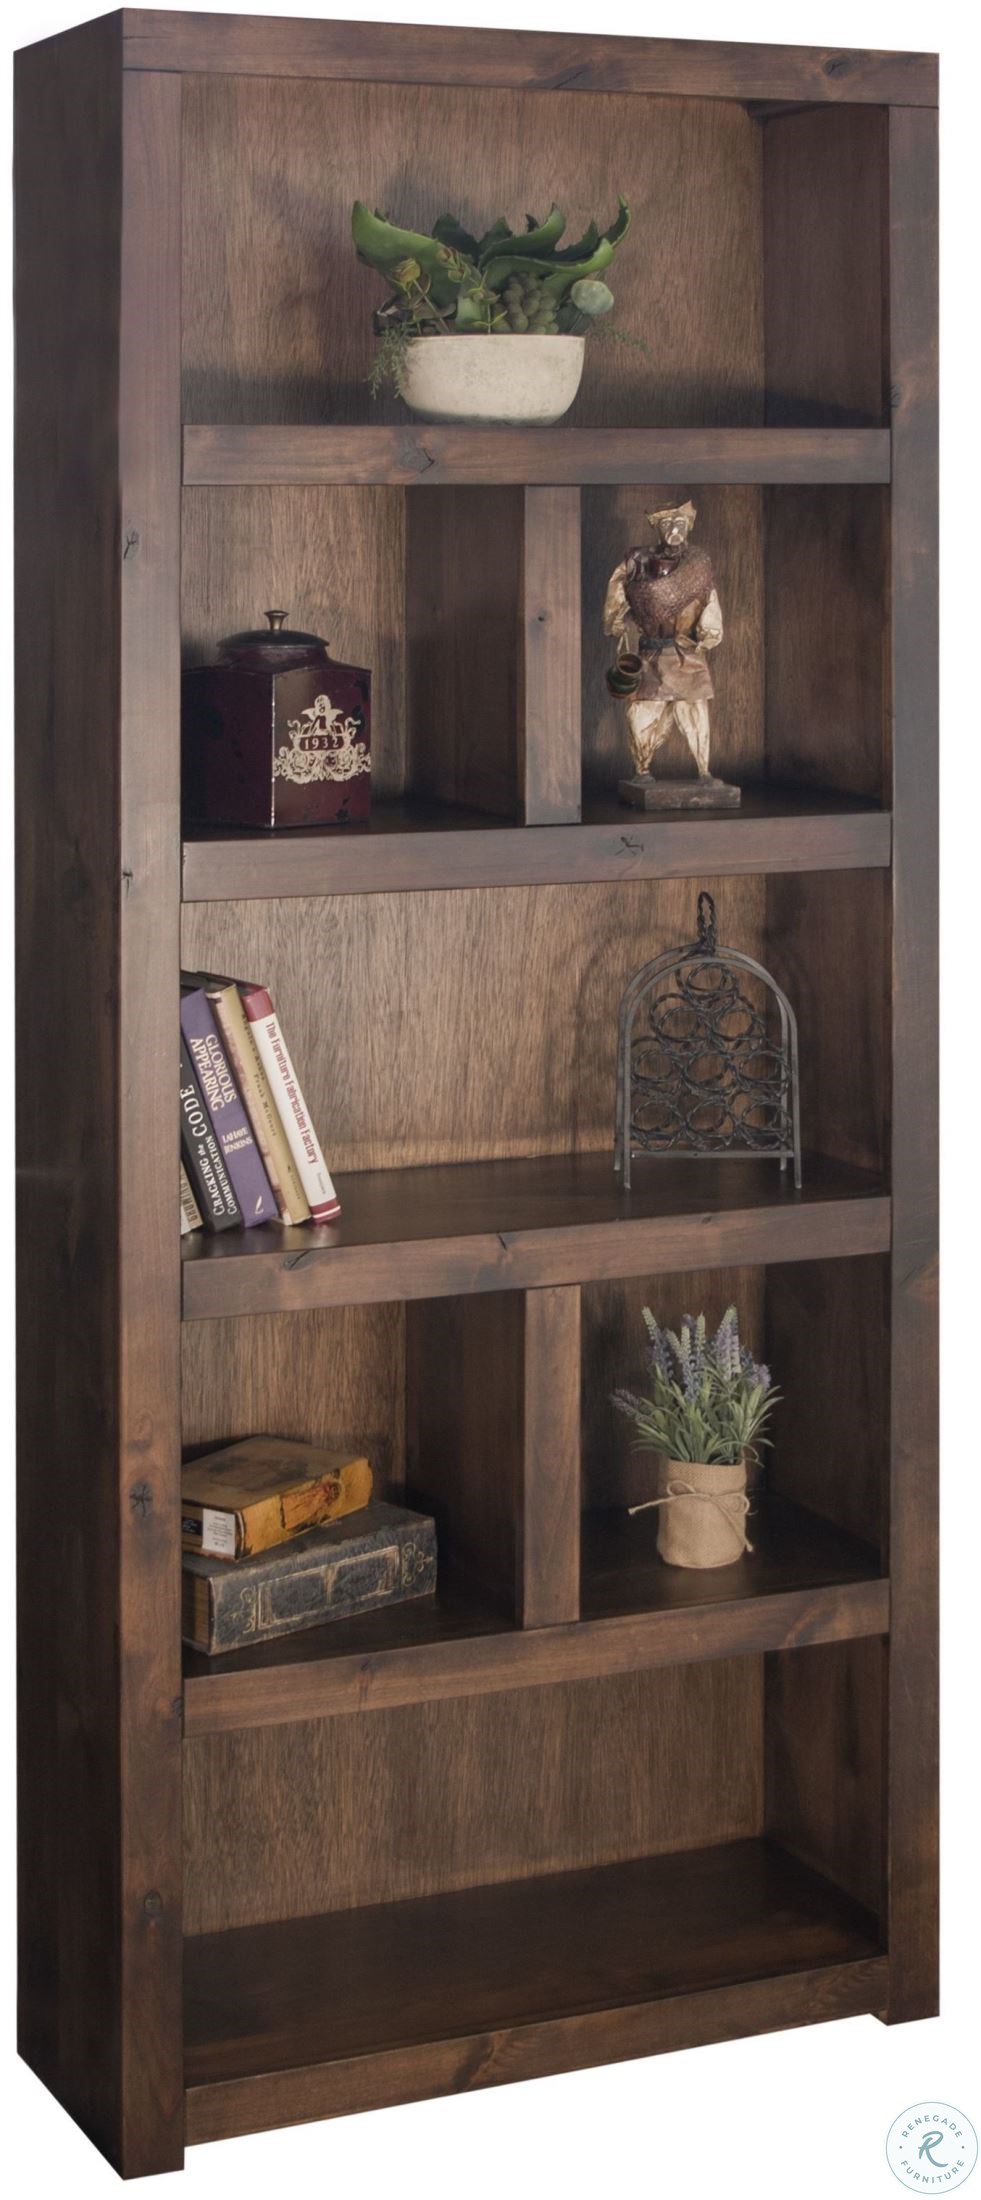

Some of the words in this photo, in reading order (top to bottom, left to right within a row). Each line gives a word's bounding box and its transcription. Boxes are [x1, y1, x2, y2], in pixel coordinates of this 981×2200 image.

[304, 737, 339, 750] 1932
[190, 1038, 225, 1112] APPEARING
[205, 1033, 237, 1103] GLORIOUS
[265, 1021, 277, 1039] The
[271, 1038, 291, 1081] Furniture
[285, 1080, 307, 1130] Fabrication
[300, 1128, 319, 1164] Factory
[180, 1084, 208, 1137] CODE
[197, 1143, 206, 1156] the
[205, 1135, 237, 1215] COMMUNICATION
[200, 1157, 225, 1216] CRACKING
